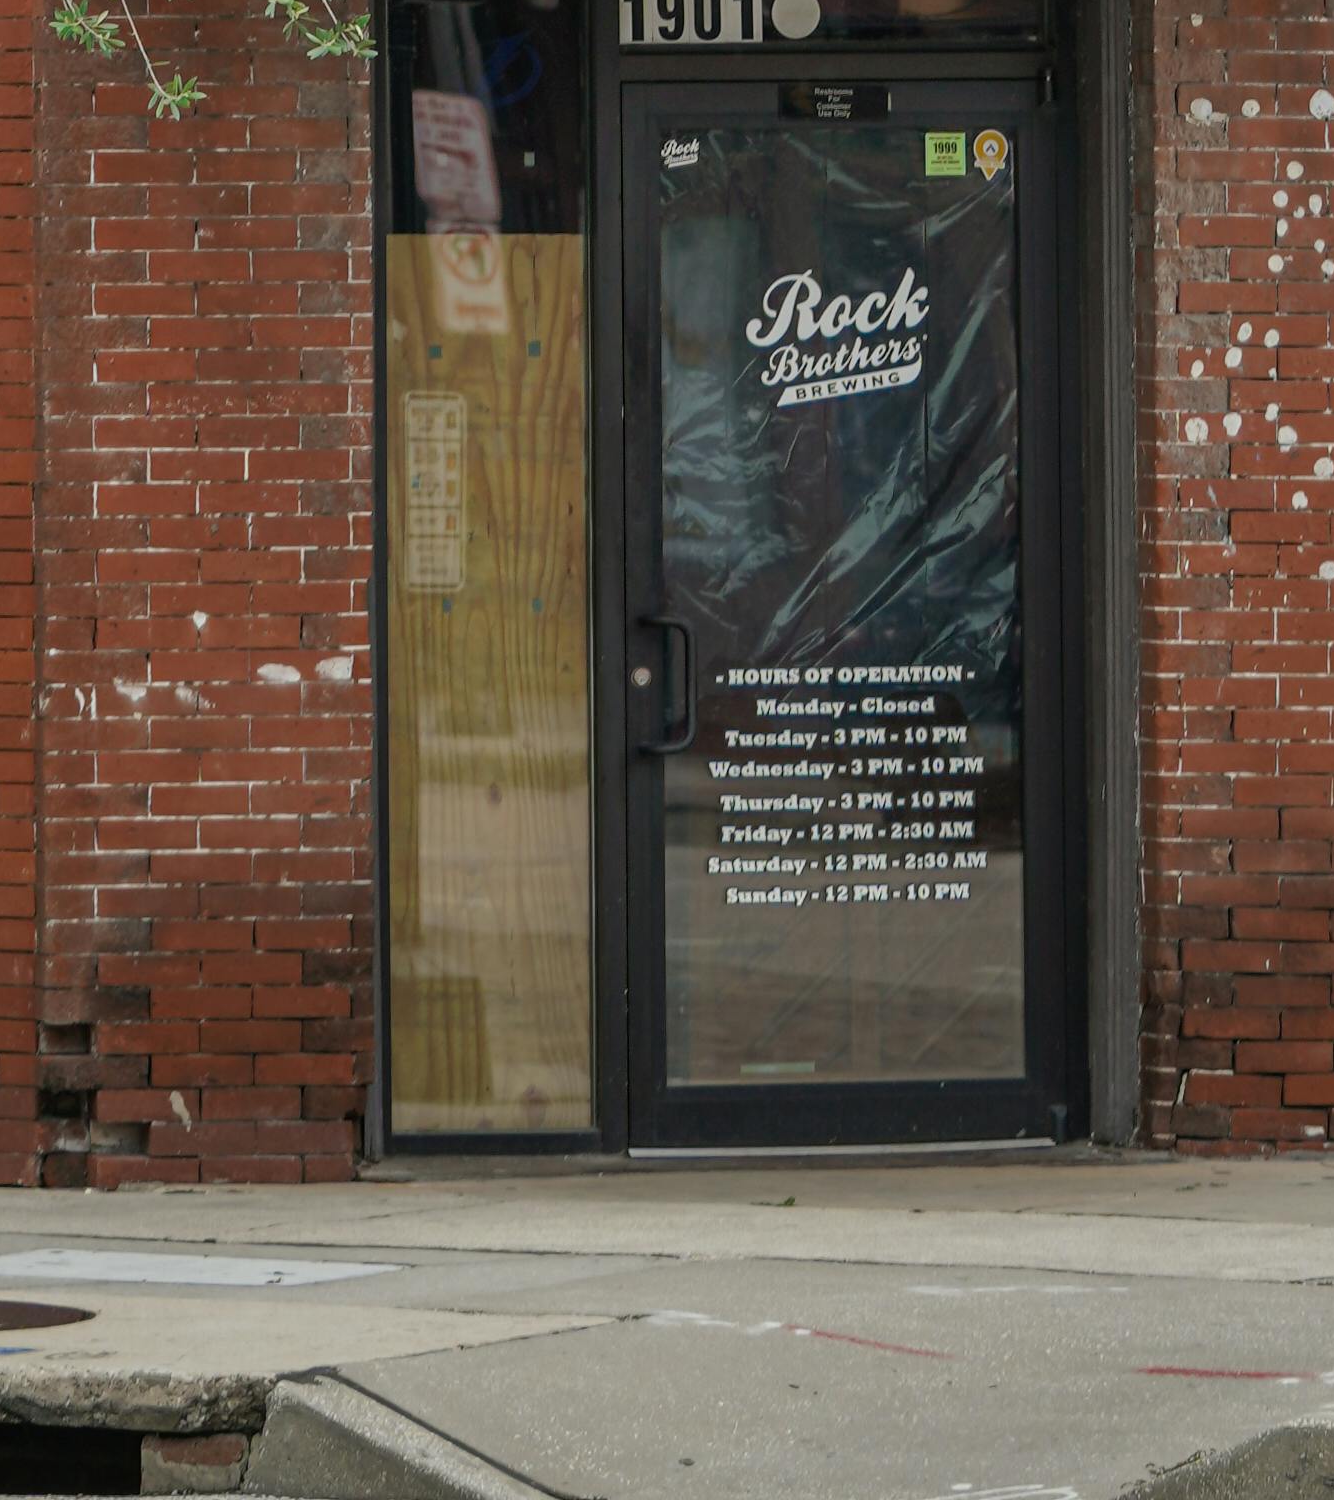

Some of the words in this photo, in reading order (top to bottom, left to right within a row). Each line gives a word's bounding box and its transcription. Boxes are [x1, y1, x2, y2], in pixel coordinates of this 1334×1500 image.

[660, 138, 700, 157] Rock
[745, 267, 930, 347] Rock
[760, 335, 922, 386] Brothers
[796, 371, 900, 400] BREWING
[728, 668, 800, 685] HOURS
[804, 667, 834, 684] OF
[838, 665, 963, 683] OPERATION
[756, 698, 847, 718] Monday
[862, 696, 935, 714] Closed
[725, 730, 817, 750] Tuesday
[834, 728, 846, 745] 3
[851, 727, 886, 745] PM
[904, 727, 927, 744] 10
[932, 726, 967, 743] PM
[709, 760, 835, 779] Wednesday
[851, 759, 863, 775] 3
[868, 758, 903, 775] PM
[921, 757, 944, 774] 10
[948, 756, 984, 774] PM
[720, 794, 824, 814] Thursday
[840, 793, 852, 809] 3
[857, 791, 893, 809] PM
[911, 791, 934, 808] 10
[939, 790, 975, 808] PM
[721, 825, 793, 846] Friday
[810, 824, 833, 840] 12
[838, 823, 873, 840] PM
[891, 822, 934, 839] 2:30
[938, 821, 974, 838] AM
[708, 856, 807, 876] Saturday
[824, 855, 847, 871] 12
[852, 854, 888, 871] PM
[905, 852, 948, 870] 2:30
[952, 851, 988, 869] AM
[726, 887, 808, 907] Sunday
[825, 885, 849, 902] 12
[853, 884, 889, 901] PM
[906, 884, 931, 900] 10
[935, 883, 970, 900] PM
